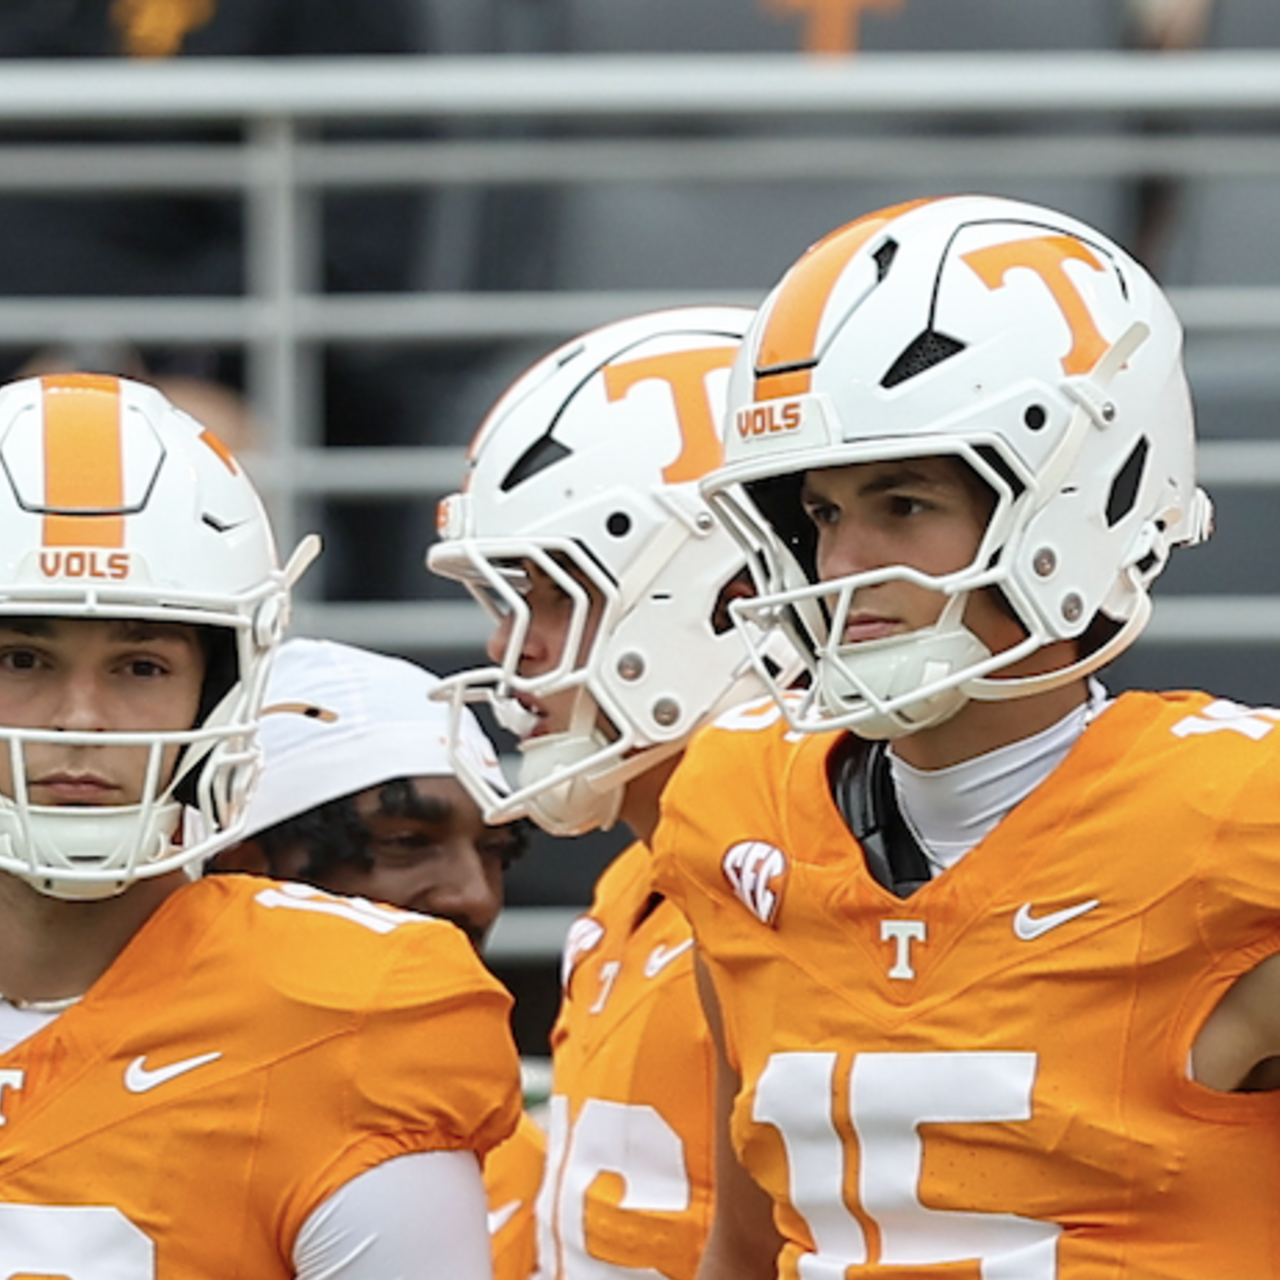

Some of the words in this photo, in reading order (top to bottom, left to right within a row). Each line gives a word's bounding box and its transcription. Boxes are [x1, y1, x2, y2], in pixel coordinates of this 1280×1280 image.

[960, 236, 1128, 376] T
[600, 346, 740, 485] T
[736, 402, 801, 438] VOLS
[38, 551, 130, 580] VOLS
[879, 919, 927, 980] T
